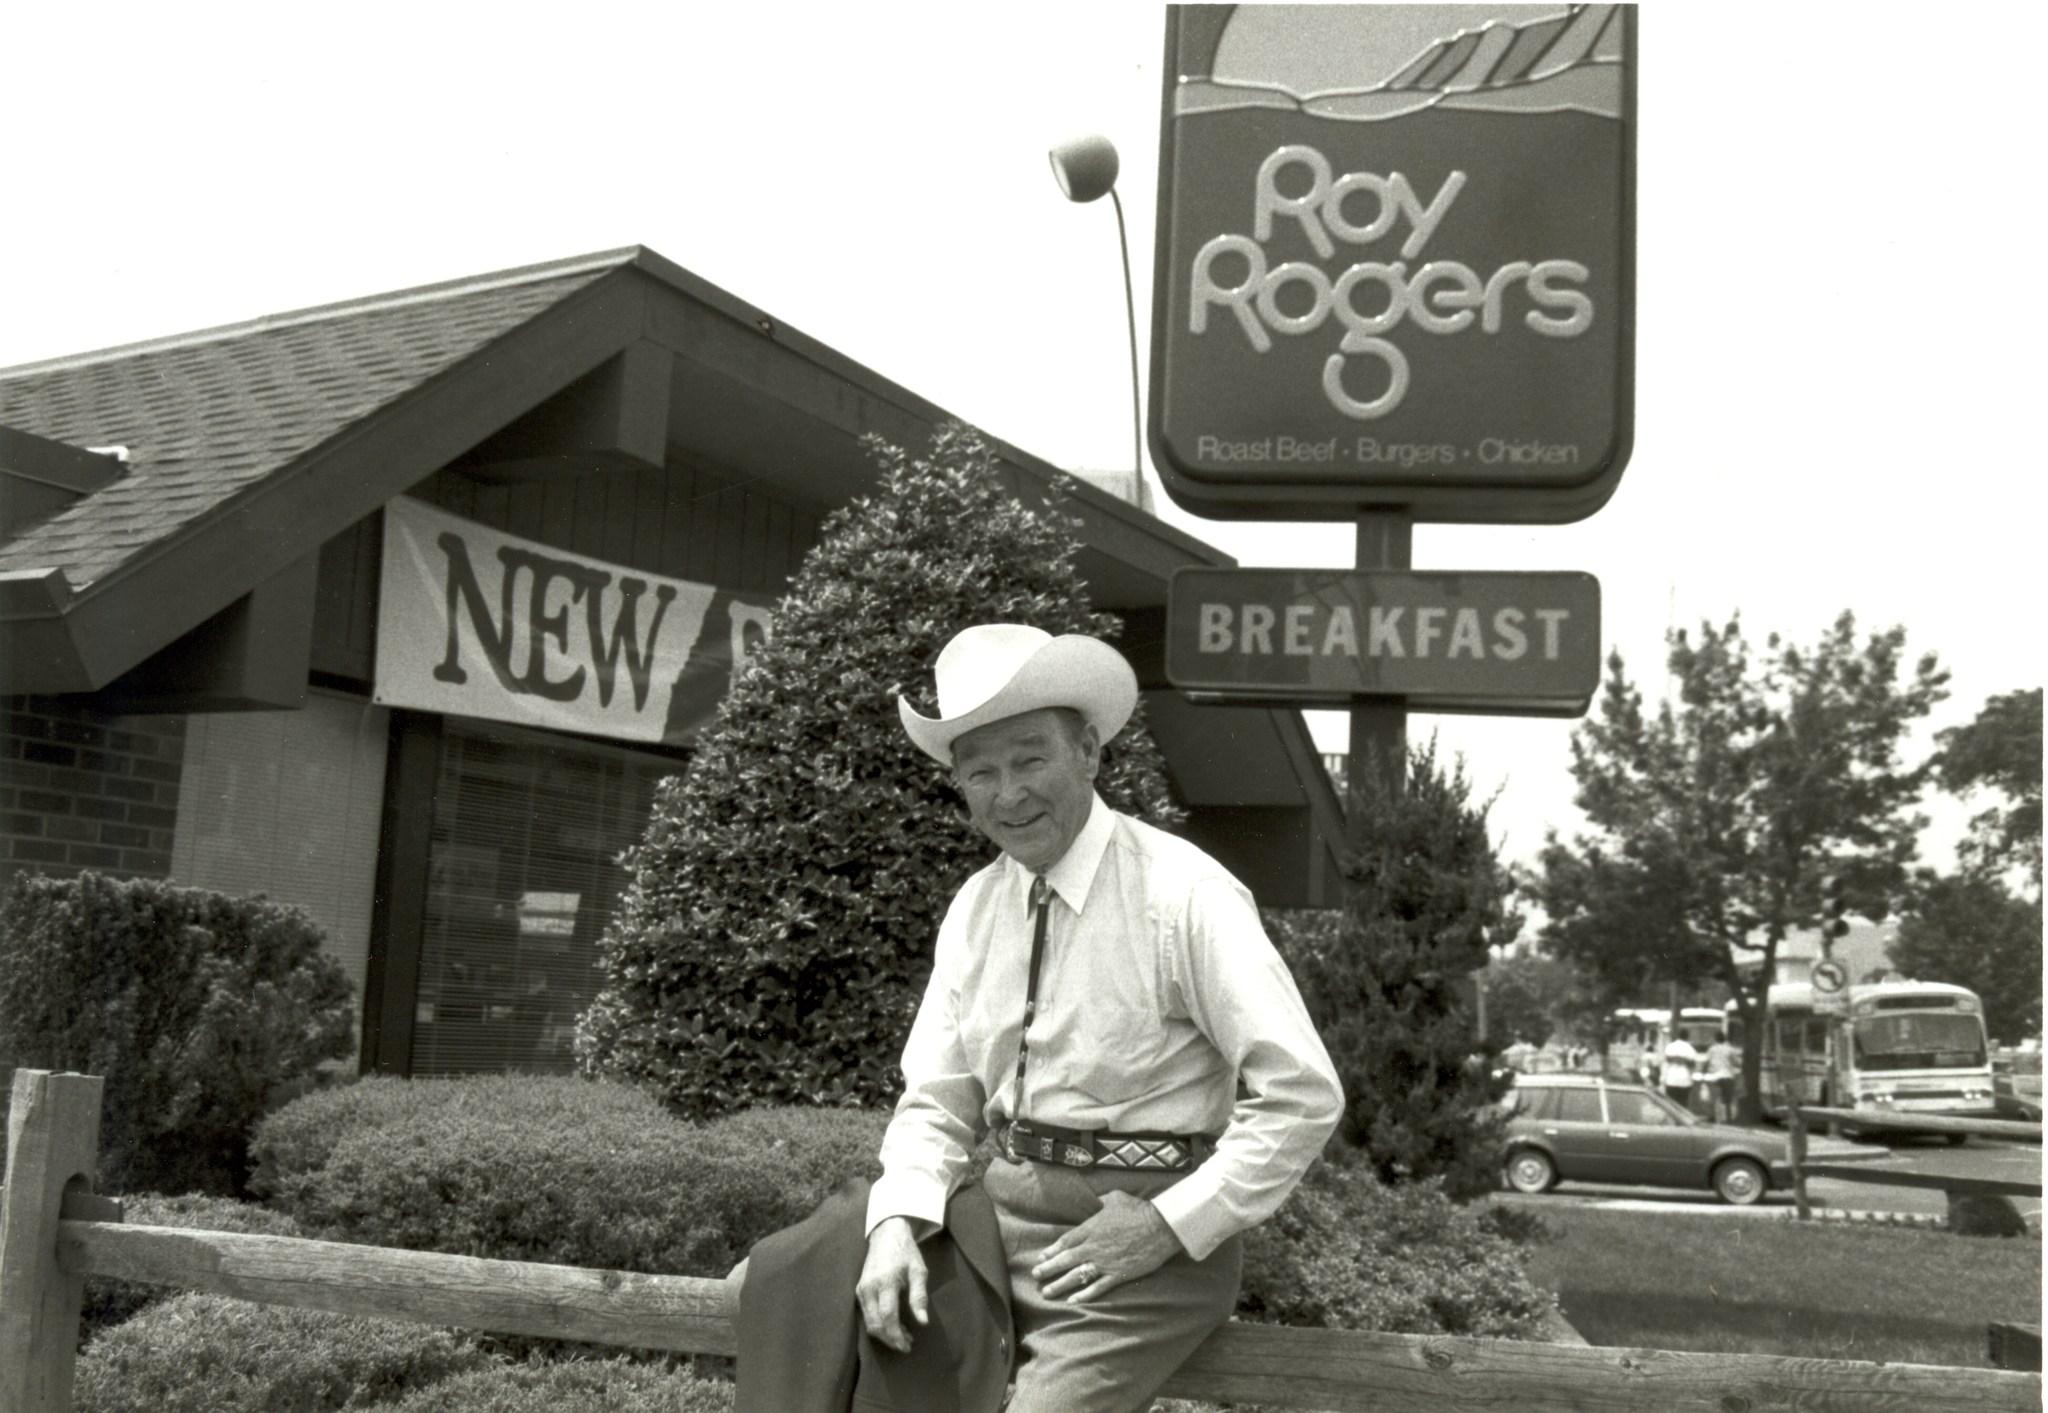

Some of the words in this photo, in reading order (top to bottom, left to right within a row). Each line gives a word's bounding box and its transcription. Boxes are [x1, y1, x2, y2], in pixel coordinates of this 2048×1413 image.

[1254, 144, 1467, 258] Roy
[1189, 234, 1593, 420] Rogers
[1198, 435, 1272, 462] Roast
[1276, 436, 1338, 462] Beef
[1357, 437, 1456, 468] Burgers
[1478, 437, 1578, 464] Chicken
[433, 531, 677, 713] NEW
[1199, 603, 1571, 661] BREAKFAST
